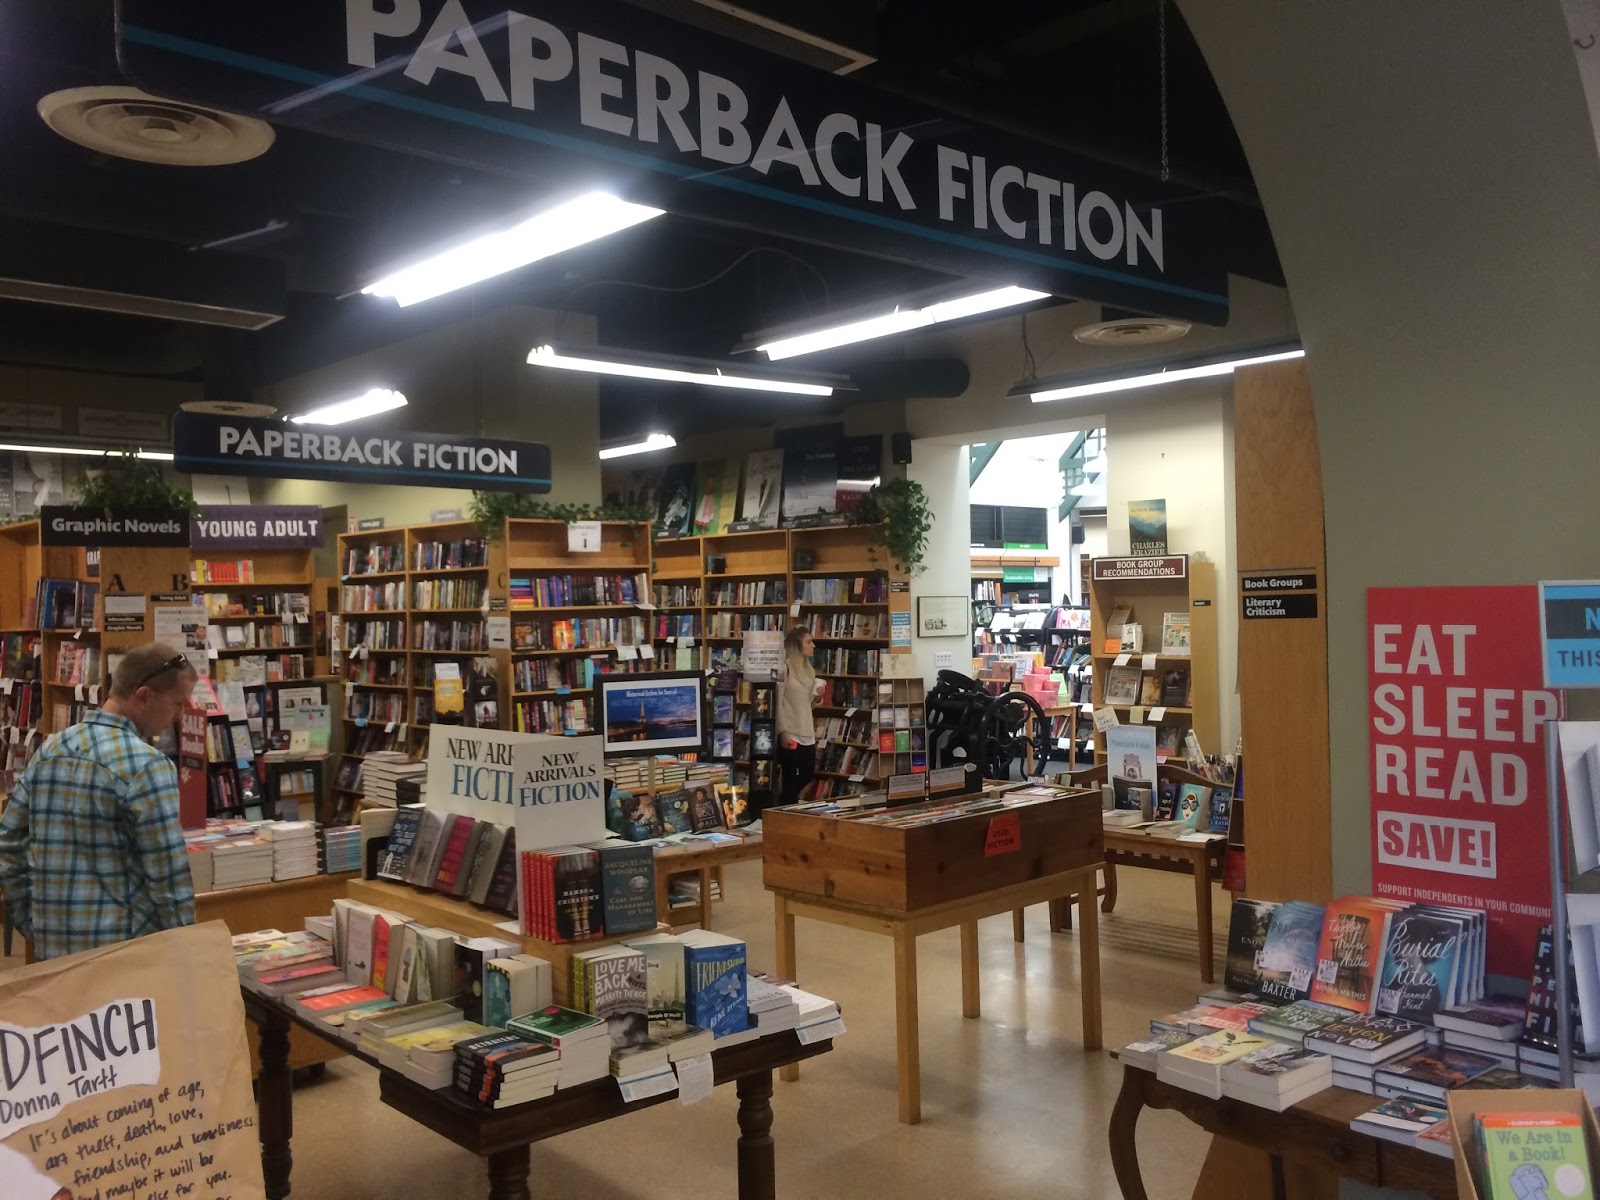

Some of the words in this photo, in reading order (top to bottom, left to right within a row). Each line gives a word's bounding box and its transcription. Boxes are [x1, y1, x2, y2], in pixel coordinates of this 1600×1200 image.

[346, 0, 917, 211] PAPERBACK
[937, 144, 1164, 273] FICTION
[219, 426, 404, 467] PAPERBACK
[413, 441, 518, 476] FICTION
[52, 517, 121, 535] Graphic
[124, 519, 181, 534] Novels
[197, 520, 257, 538] YOUNG
[263, 519, 318, 537] ADULT
[1131, 541, 1166, 550] CHARLES
[1133, 548, 1165, 556] FRAZIER
[1102, 567, 1176, 577] RECOMMENDATIONS
[1116, 561, 1137, 569] BOOK
[1137, 559, 1164, 568] GROUP
[107, 574, 126, 592] A
[170, 573, 189, 592] B
[1244, 578, 1268, 590] Book
[1269, 577, 1303, 590] Groups
[1245, 597, 1282, 610] Literary
[1245, 606, 1286, 617] Criticism
[1373, 623, 1477, 676] EAT
[1373, 682, 1558, 744] SLEEP
[182, 713, 205, 736] SALE
[446, 738, 482, 762] NEW
[541, 751, 580, 768] NEW
[451, 763, 514, 805] FICTI
[523, 764, 597, 785] ARRIVALS
[1375, 743, 1528, 807] READ
[518, 781, 601, 808] FICTION
[992, 828, 1009, 838] USED
[987, 838, 1015, 850] FICTION
[1382, 819, 1492, 868] SAVE!
[605, 858, 653, 869] JACQUELINE
[609, 866, 648, 876] WINSPEAR
[557, 894, 600, 906] CHINATOWN
[562, 888, 589, 897] MAMBO
[1377, 882, 1412, 897] SUPPORT
[1413, 888, 1473, 906] INDEPENDENTS
[1474, 897, 1484, 908] IN
[1485, 898, 1508, 913] YOUR
[1509, 902, 1553, 919] COMMUNI
[1386, 917, 1457, 960] Burial
[595, 958, 626, 981] LOVE
[626, 955, 646, 973] ME
[1384, 958, 1438, 987] Rites
[595, 973, 632, 996] BACK
[1261, 980, 1297, 1001] BAXTER
[1397, 985, 1433, 1001] Hannah
[1340, 989, 1367, 1001] MATHIS
[1402, 998, 1424, 1010] Kent
[468, 1034, 521, 1050] BETRAYERS
[1307, 1030, 1353, 1044] NOV
[1324, 1022, 1393, 1042] LEXICON
[0, 999, 156, 1092] DFINCH
[0, 1092, 61, 1125] Donna
[67, 1065, 118, 1098] Tartt
[28, 1130, 58, 1152] It's
[61, 1114, 101, 1143] about
[106, 1096, 154, 1123] coming
[158, 1087, 170, 1103] of
[177, 1079, 205, 1101] age,
[45, 1153, 69, 1171] art
[123, 1120, 167, 1143] death,
[168, 1107, 204, 1125] love,
[1496, 1130, 1520, 1145] We
[1525, 1130, 1553, 1145] Are
[73, 1153, 152, 1188] friendship,
[154, 1135, 184, 1156] and
[1508, 1151, 1518, 1162] a
[1521, 1146, 1566, 1162] Book!
[106, 1175, 148, 1200] maybe
[153, 1169, 165, 1183] it
[170, 1158, 194, 1177] will
[199, 1152, 214, 1167] be
[174, 1182, 195, 1197] for
[206, 1169, 233, 1190] you.
